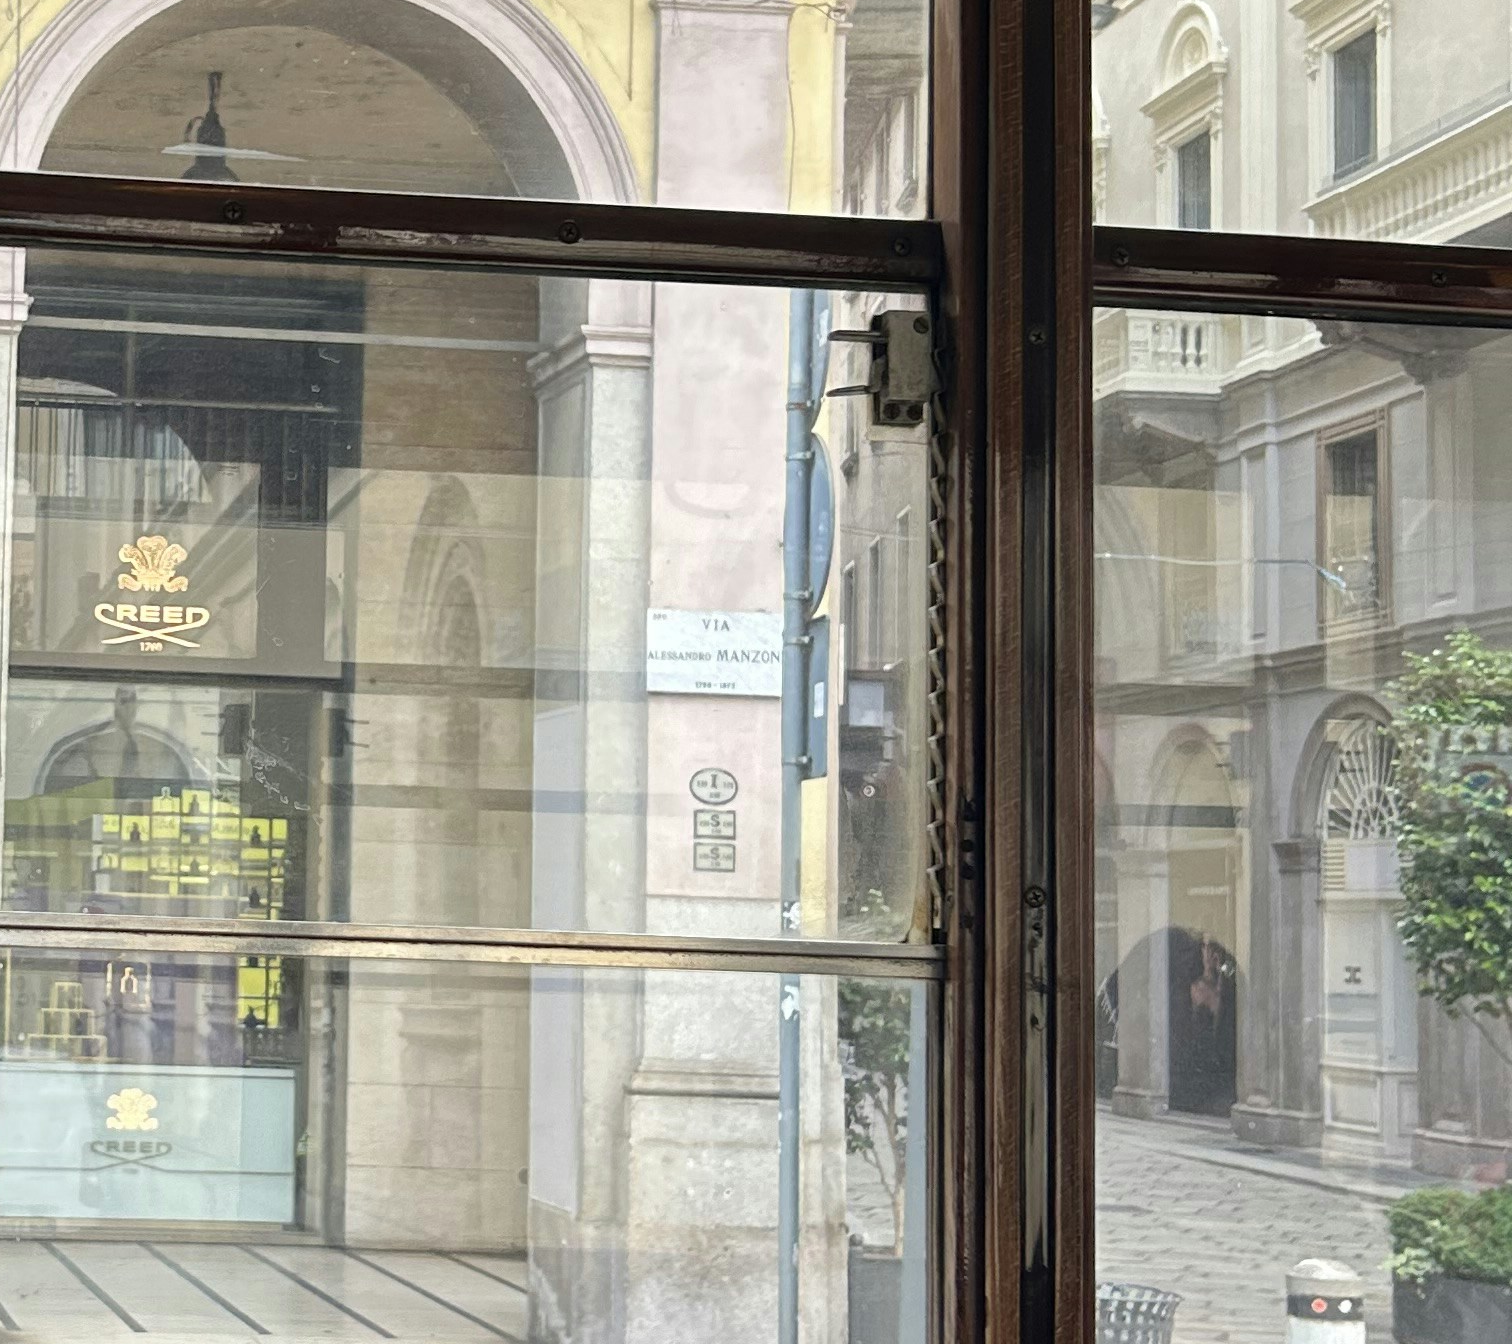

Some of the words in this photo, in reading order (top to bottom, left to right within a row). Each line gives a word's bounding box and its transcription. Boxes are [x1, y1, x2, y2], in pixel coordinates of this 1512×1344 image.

[94, 603, 210, 635] CREED
[701, 618, 730, 632] VIA
[648, 650, 712, 662] ALESSANDRO
[716, 649, 781, 664] MANZON
[710, 814, 720, 828] S
[710, 847, 720, 861] S
[90, 1140, 172, 1162] CREED
